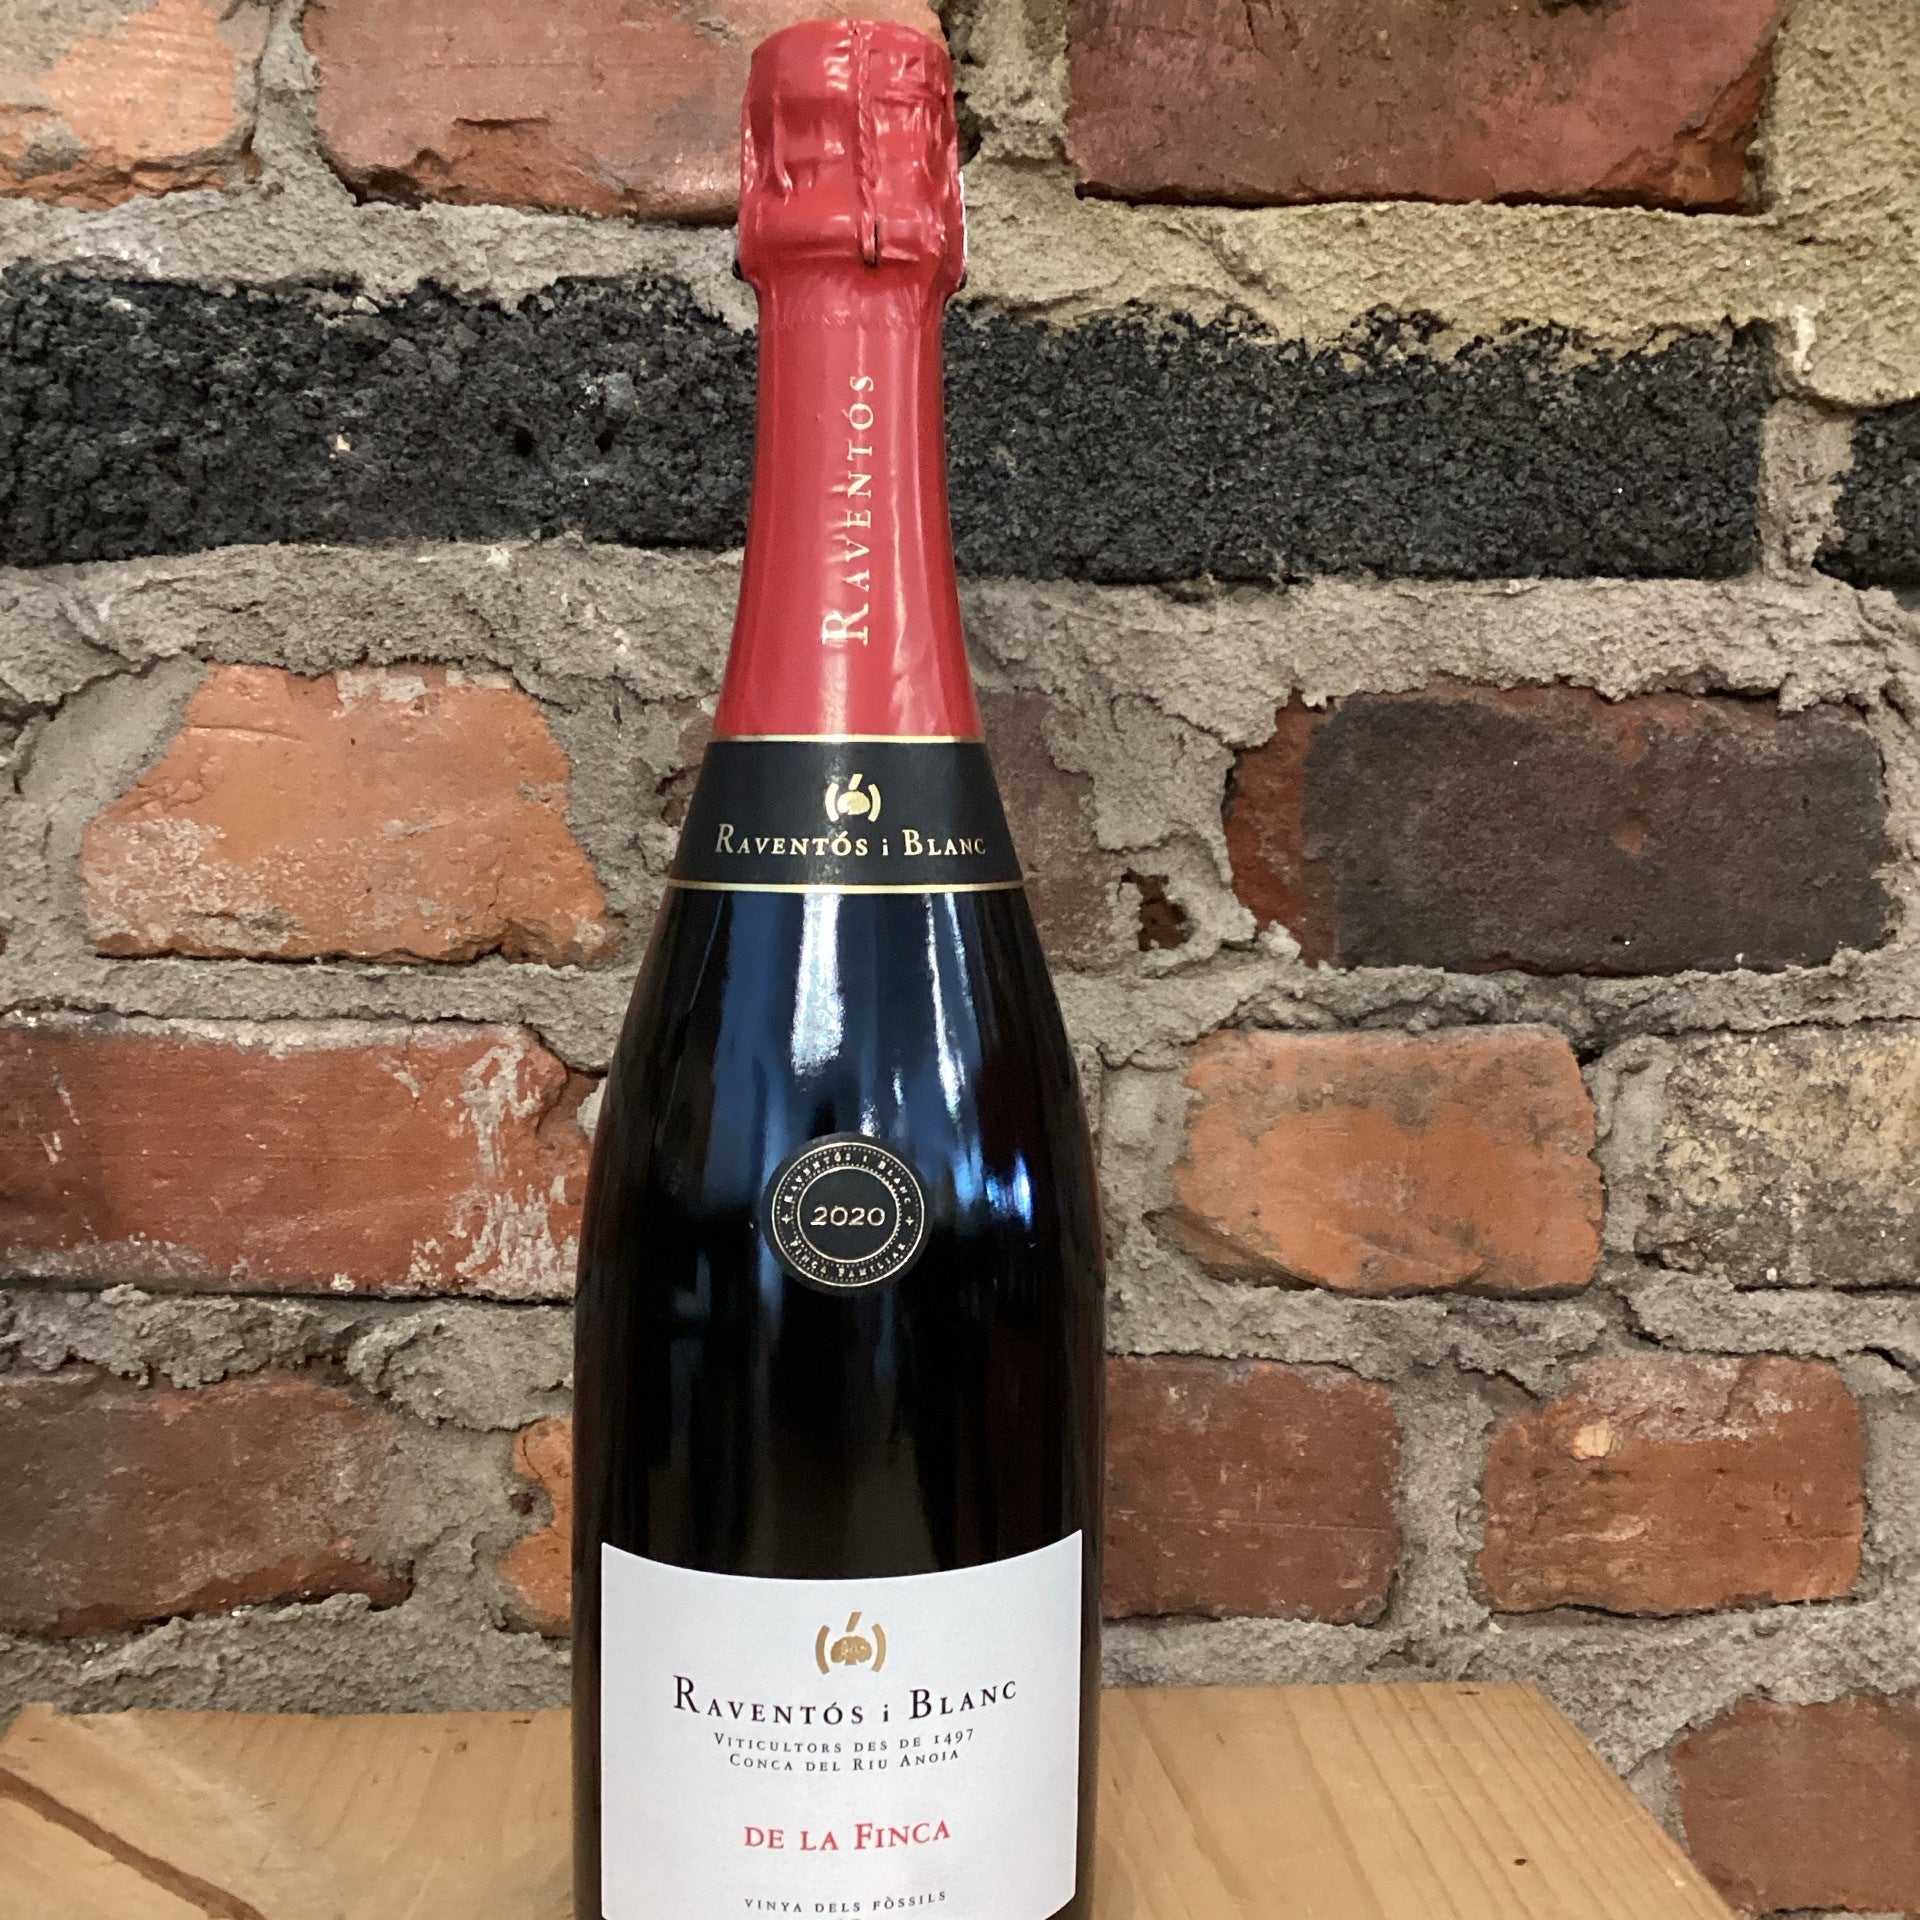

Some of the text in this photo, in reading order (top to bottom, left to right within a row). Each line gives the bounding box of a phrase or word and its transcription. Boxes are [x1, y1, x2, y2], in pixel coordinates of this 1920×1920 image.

[820, 375, 874, 646] RAVENTÓS
[714, 823, 868, 856] RAVENTÓS
[902, 829, 986, 856] BLANC
[810, 1206, 886, 1226] 2020
[673, 1675, 864, 1725] RAVENTÓS
[909, 1681, 1018, 1720] BLANC
[714, 1728, 975, 1753] VITICULTORS DES DE 1497
[729, 1750, 960, 1772] CONCA DEL RIU ANOIA
[744, 1820, 951, 1851] DE LA FINCA
[744, 1891, 946, 1913] VINYA DELS FÒSSILS
